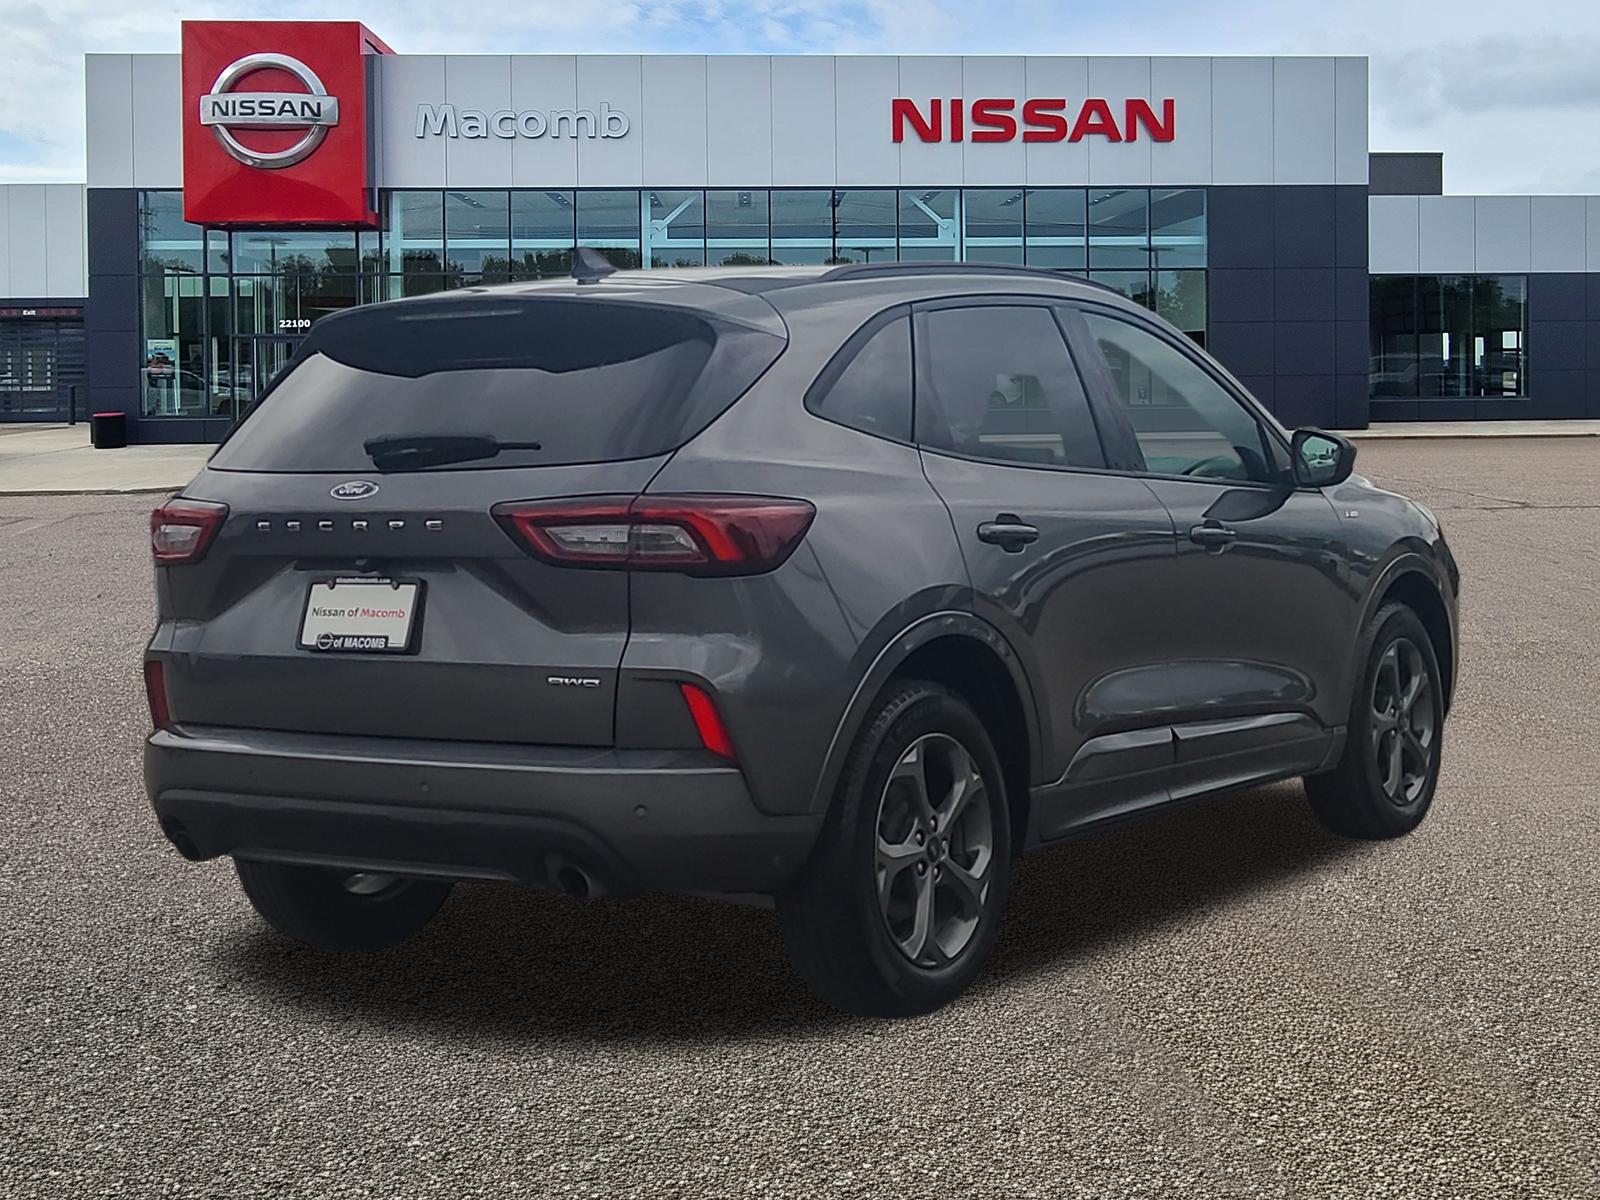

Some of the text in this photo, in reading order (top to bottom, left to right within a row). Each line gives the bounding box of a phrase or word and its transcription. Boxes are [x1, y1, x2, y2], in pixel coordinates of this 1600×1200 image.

[212, 100, 322, 118] NISSAN
[415, 102, 630, 138] Macomb
[892, 98, 1176, 142] NISSAN
[279, 319, 311, 328] 22100
[338, 482, 368, 495] Ford
[257, 520, 443, 531] ESCAPE
[312, 607, 405, 618] Nissan of Macomb
[333, 637, 386, 649] of MACOMB
